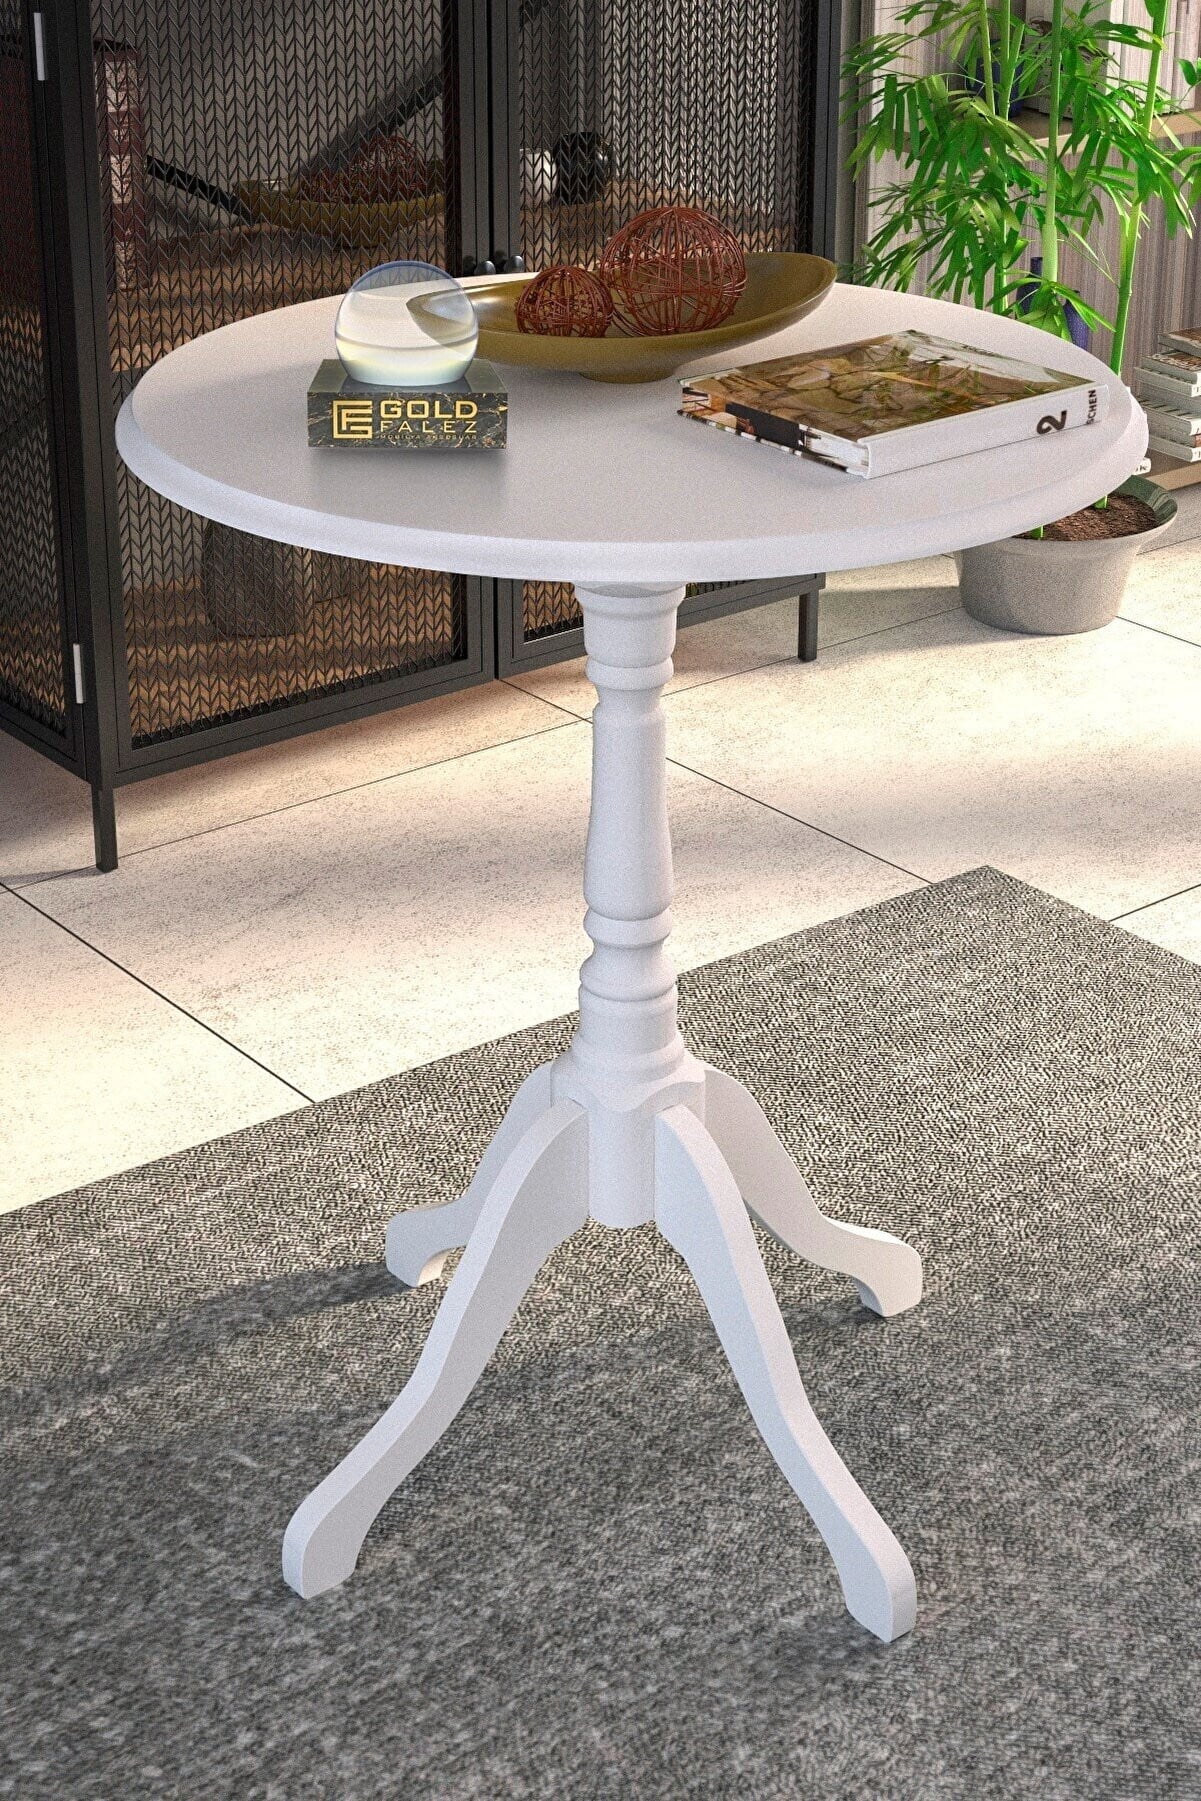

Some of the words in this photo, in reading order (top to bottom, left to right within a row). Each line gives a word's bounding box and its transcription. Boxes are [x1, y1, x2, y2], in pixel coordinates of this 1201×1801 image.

[380, 400, 478, 419] GOLD
[380, 420, 477, 433] FALEZ
[1036, 410, 1067, 434] 2
